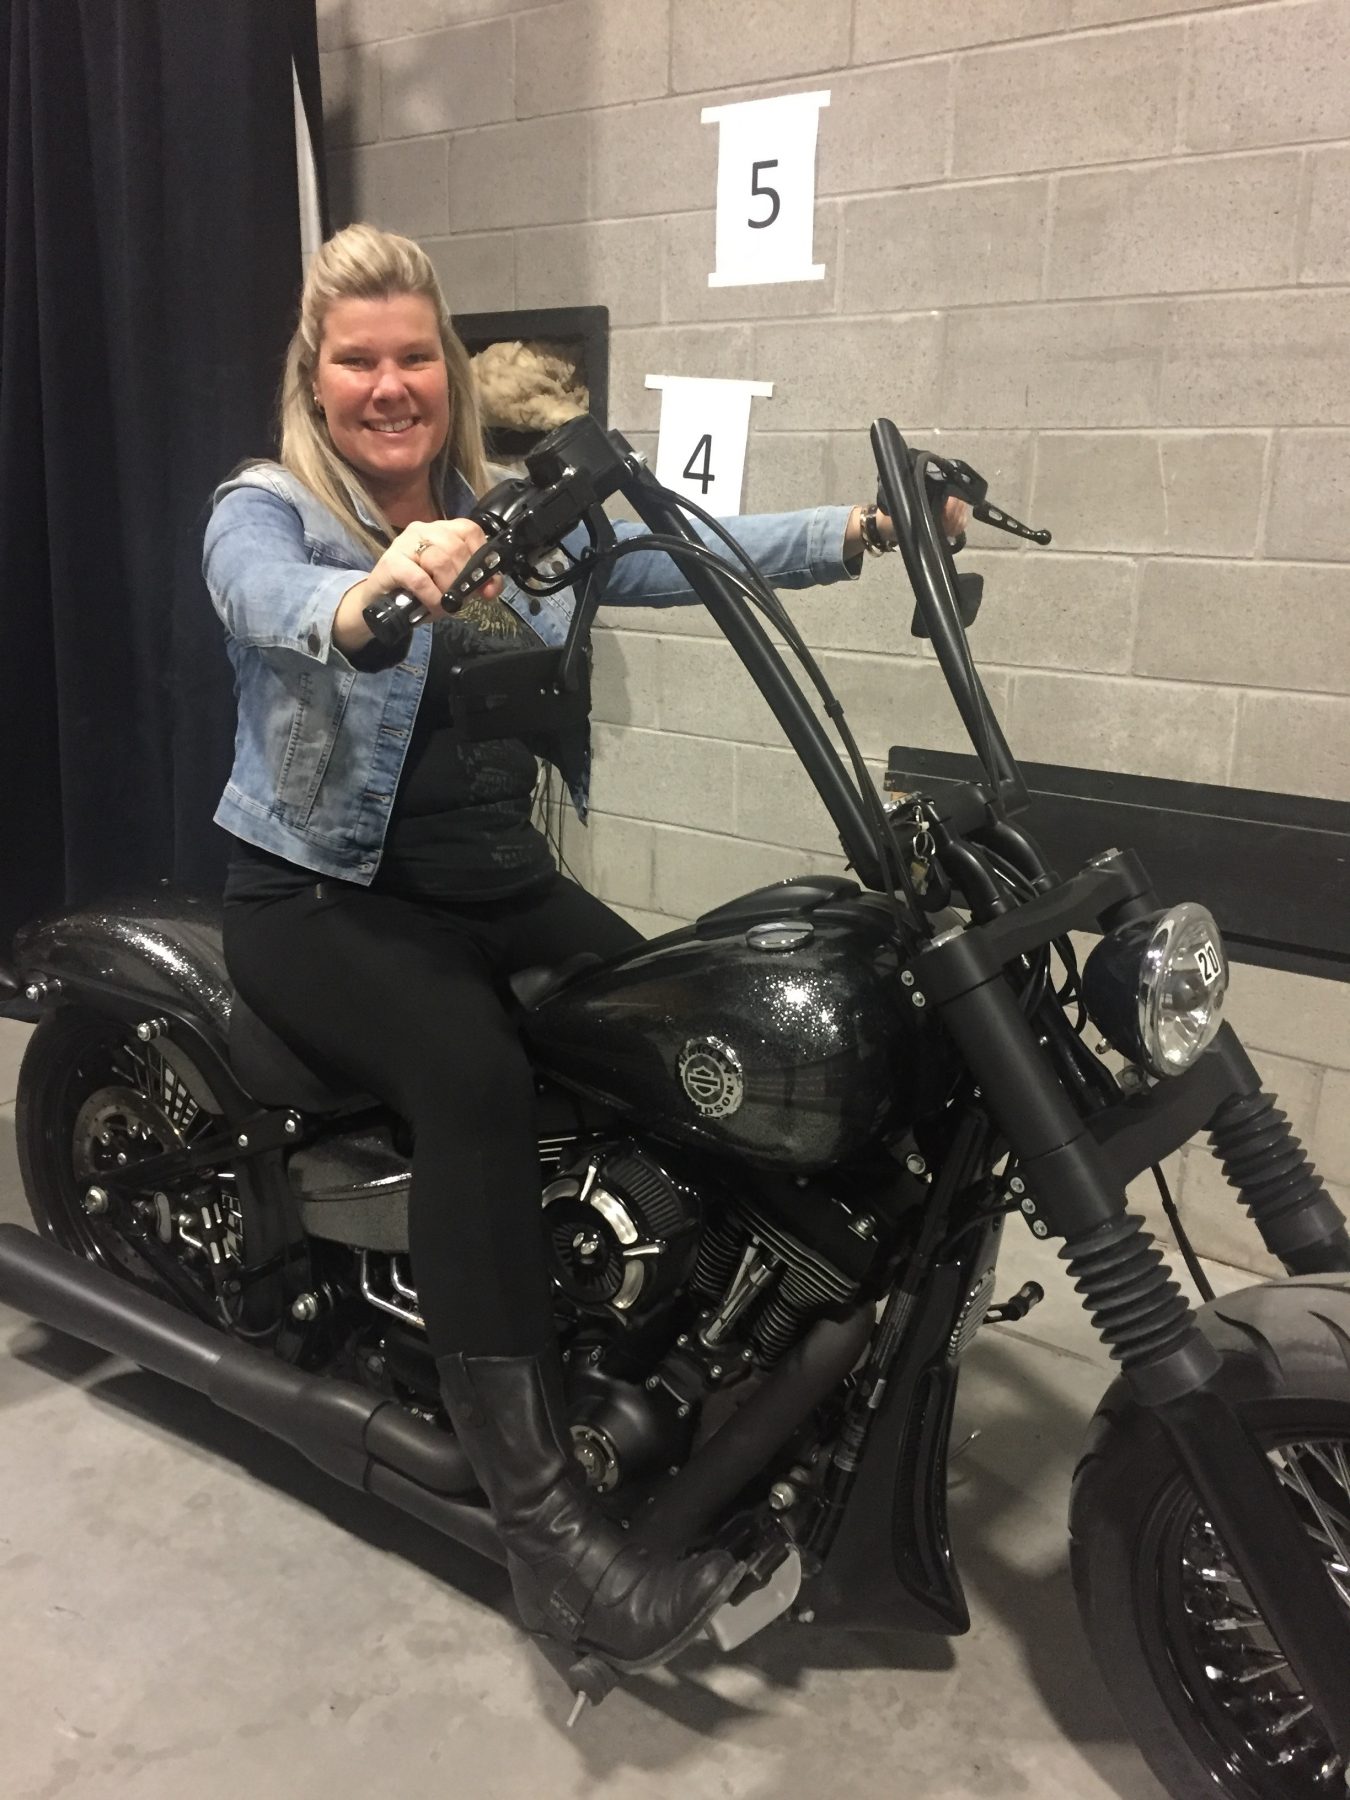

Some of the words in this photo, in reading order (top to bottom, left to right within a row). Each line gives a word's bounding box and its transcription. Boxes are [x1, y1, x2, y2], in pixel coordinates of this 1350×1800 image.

[747, 158, 782, 229] 5
[682, 433, 716, 495] 4
[1198, 944, 1220, 982] 20
